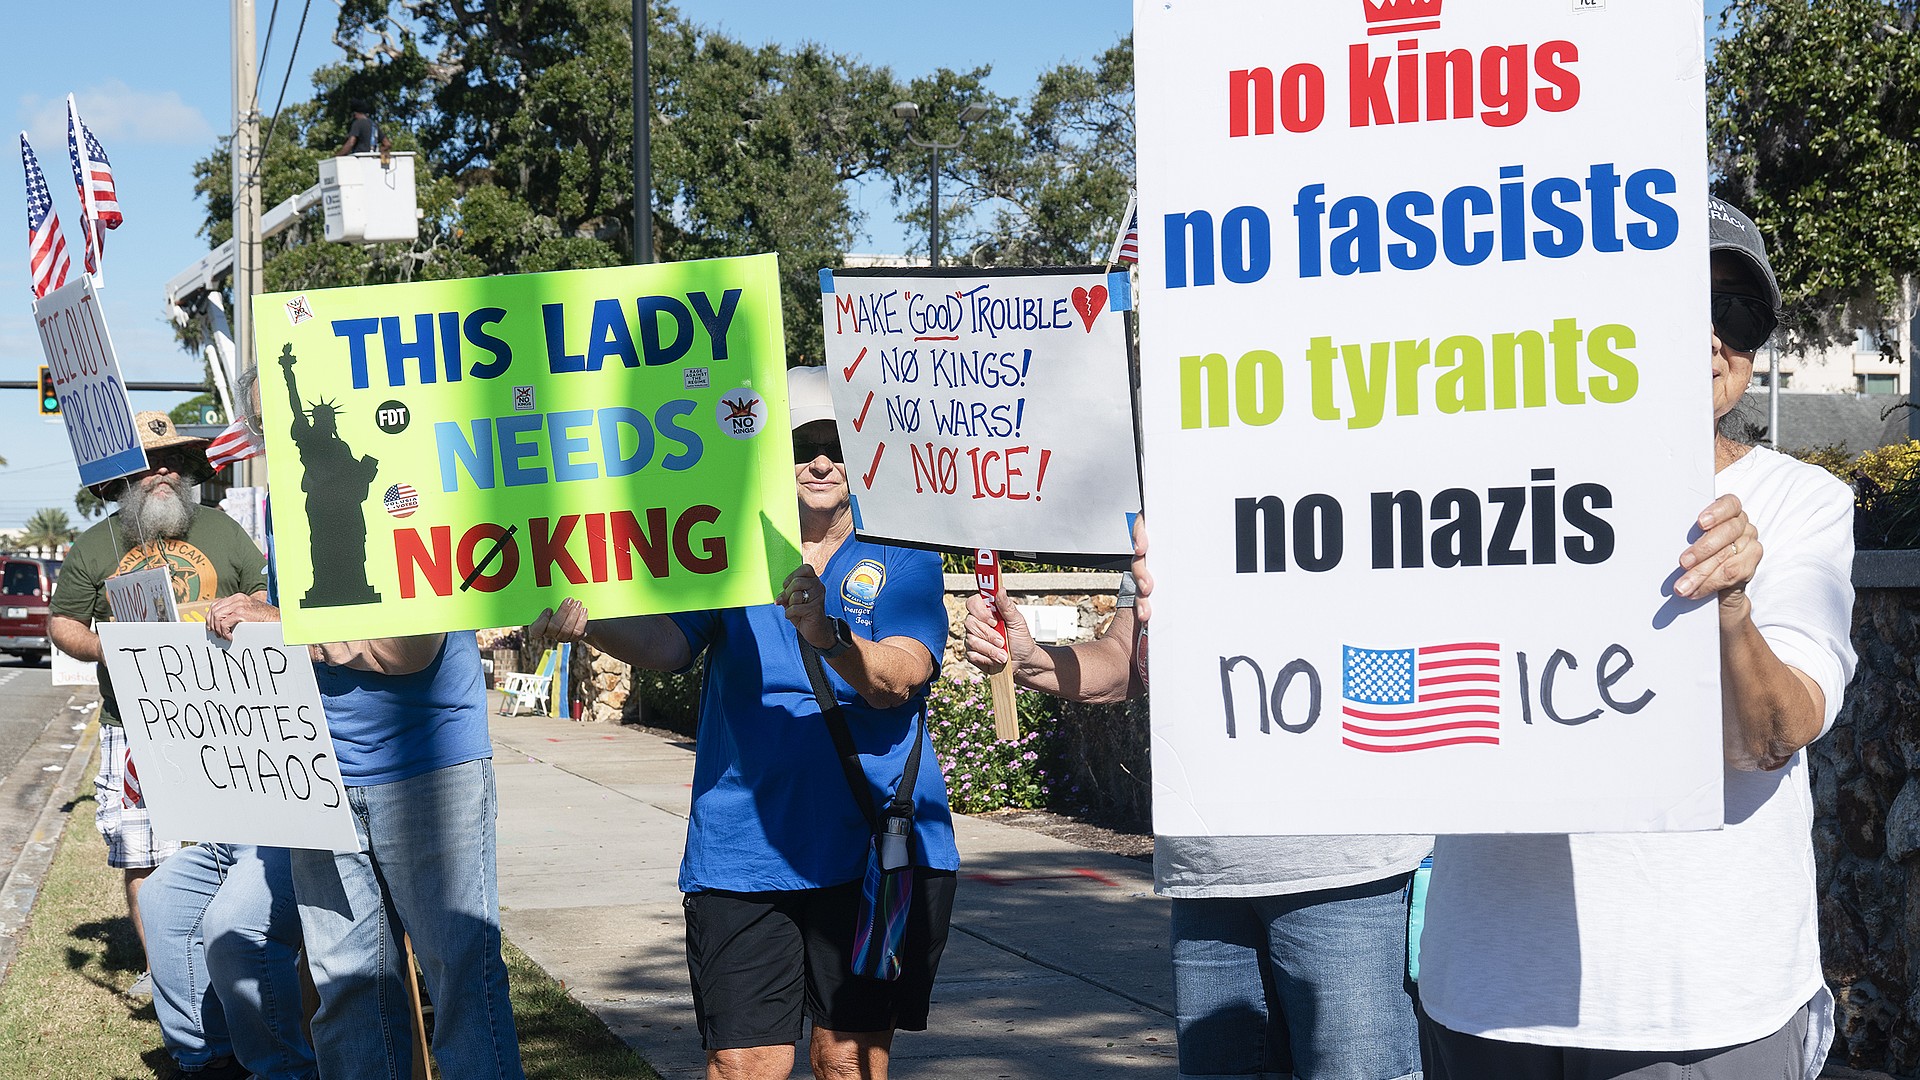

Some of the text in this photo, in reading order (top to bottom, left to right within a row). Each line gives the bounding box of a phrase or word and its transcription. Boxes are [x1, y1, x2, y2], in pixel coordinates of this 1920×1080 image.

[1228, 39, 1581, 138] no kings
[1164, 163, 1680, 289] no fascists
[1708, 210, 1746, 232] RACY
[39, 294, 108, 386] ICE OUT
[331, 288, 743, 389] THIS LADY
[835, 289, 903, 335] MAKE
[961, 284, 1073, 338] TROUBLE
[930, 348, 1033, 389] KINGS!
[1179, 317, 1640, 430] no tyrants
[60, 374, 135, 466] FOR GOOD
[378, 407, 406, 427] FDT
[434, 399, 705, 493] NEEDS
[732, 417, 754, 429] NO
[733, 427, 755, 435] KINGS
[930, 397, 1026, 438] WARS!
[966, 445, 1052, 502] ICE!
[528, 503, 729, 588] KING
[1234, 467, 1616, 573] no nazis
[178, 544, 206, 565] CAN
[119, 644, 288, 696] TRUMP
[1219, 652, 1322, 739] no
[138, 698, 317, 743] PROMOTES
[200, 744, 340, 809] CHAOS
